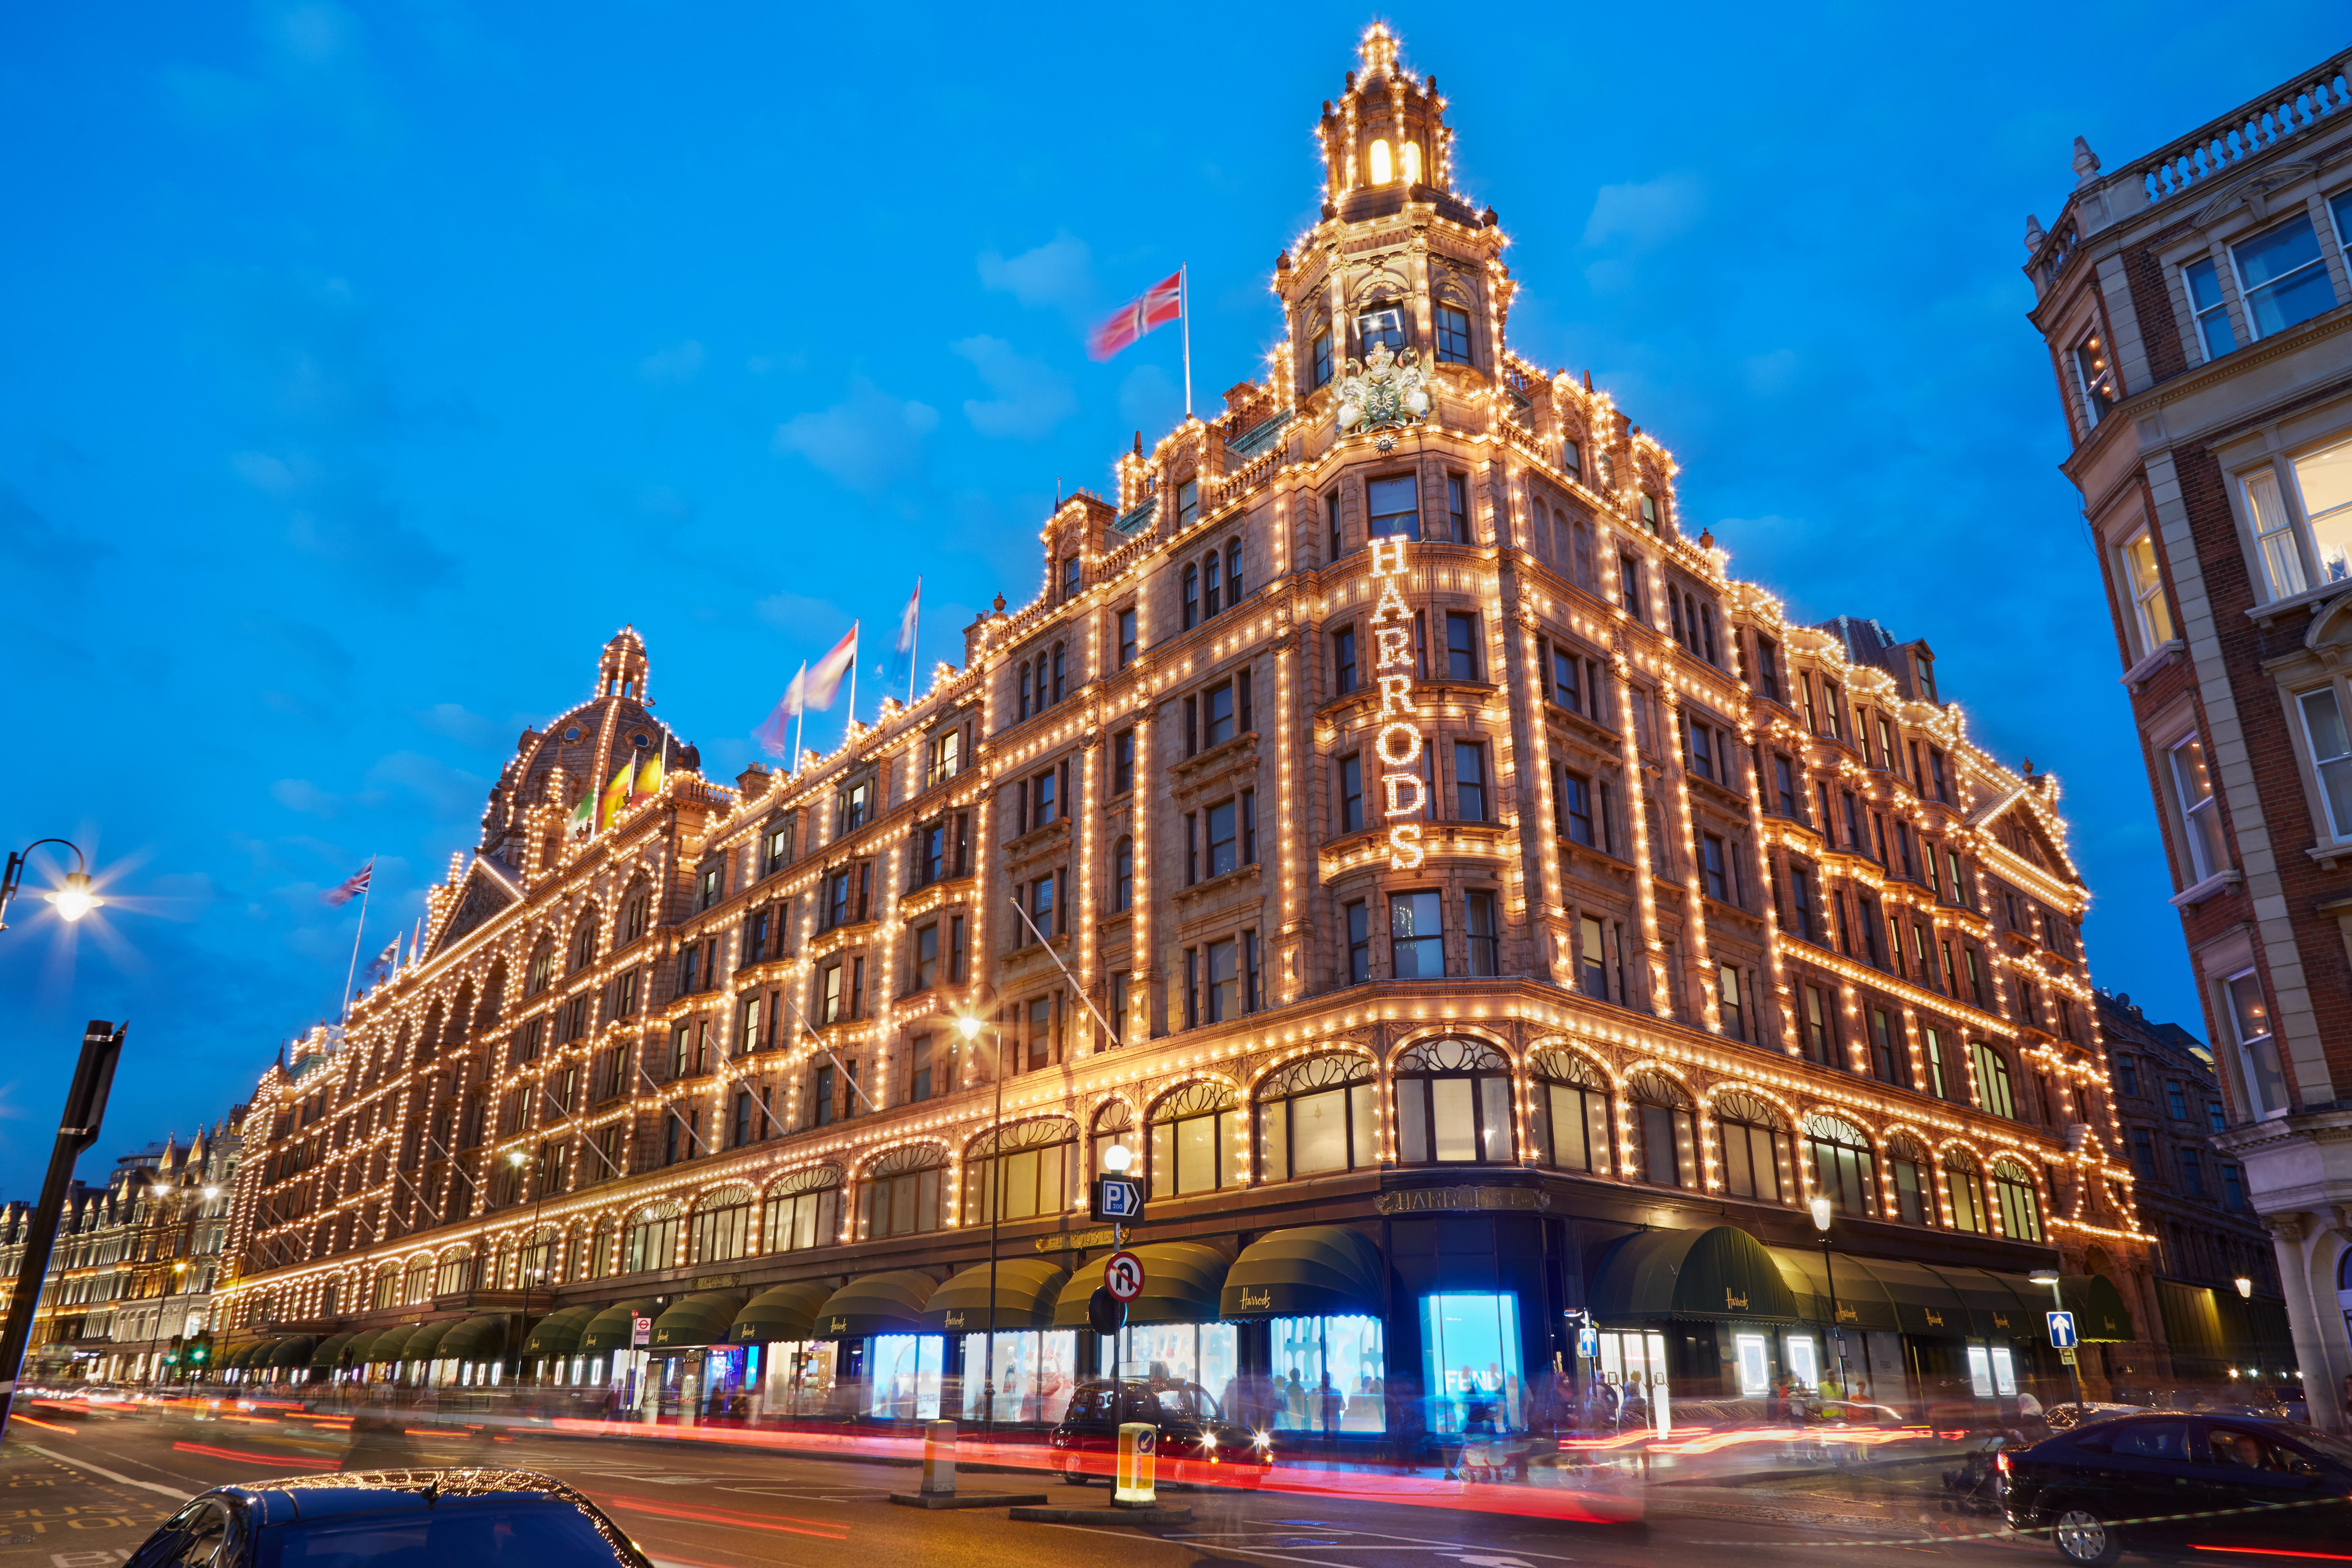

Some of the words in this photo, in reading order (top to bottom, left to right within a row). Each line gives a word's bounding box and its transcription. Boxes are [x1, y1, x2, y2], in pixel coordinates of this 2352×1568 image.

[1368, 534, 1425, 870] HARRODS
[1106, 1185, 1121, 1210] P
[1395, 1189, 1502, 1210] HARRODS
[1047, 1229, 1098, 1247] HARRODS
[1239, 1287, 1270, 1310] Harrods
[1725, 1287, 1748, 1310] Harrods
[831, 1317, 846, 1333] Harrods
[944, 1310, 964, 1328] Harrods
